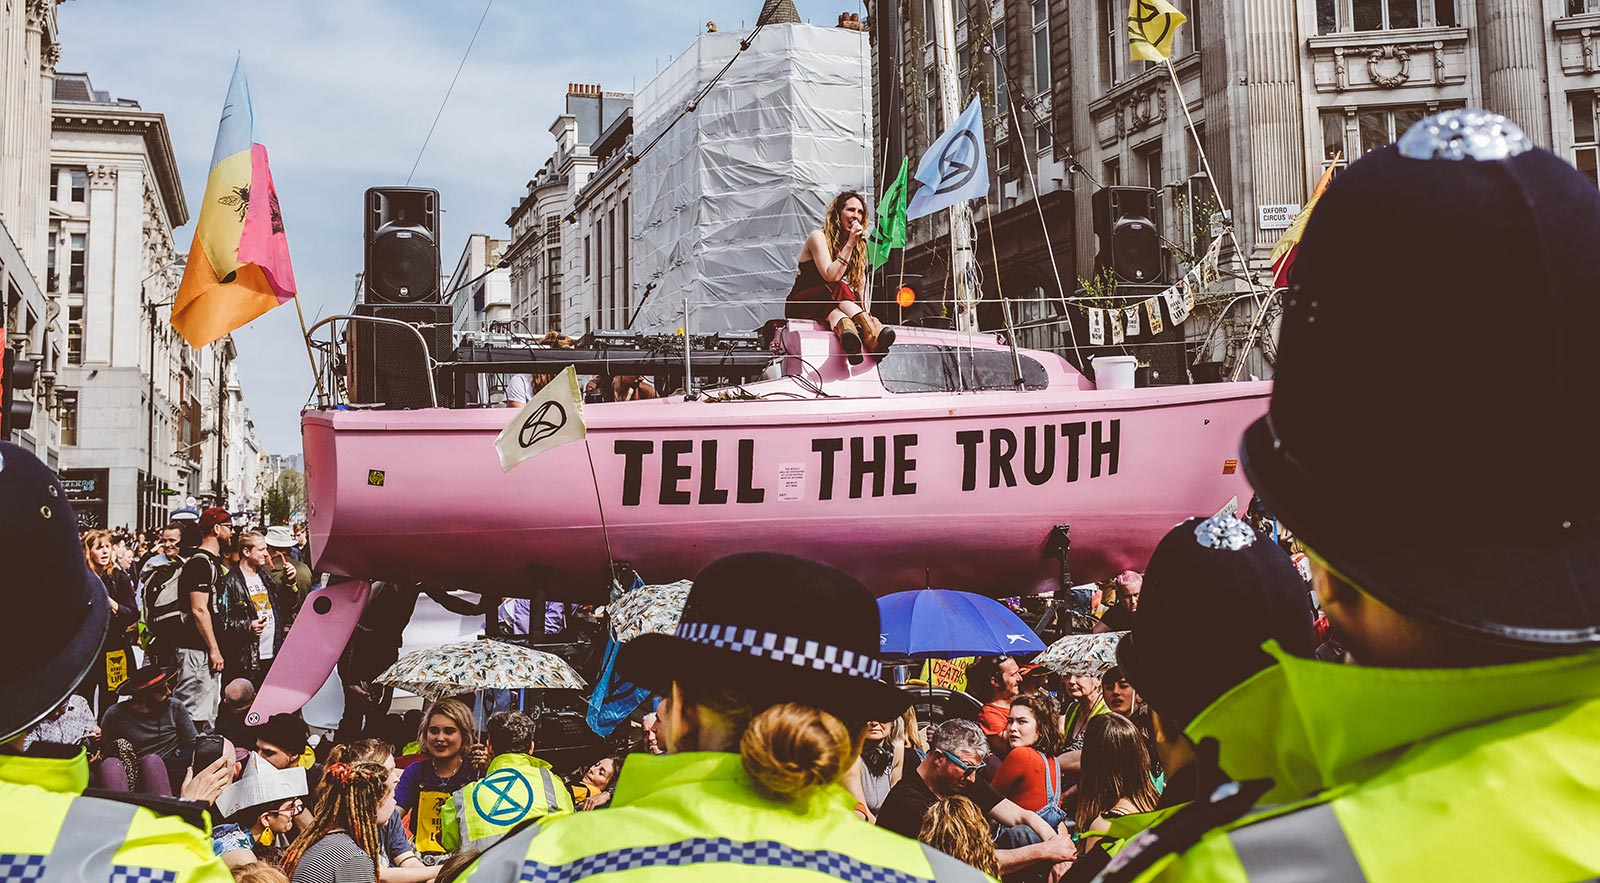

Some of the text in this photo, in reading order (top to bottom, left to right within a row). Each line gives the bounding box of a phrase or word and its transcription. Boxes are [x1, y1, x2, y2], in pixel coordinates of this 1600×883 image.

[1262, 206, 1288, 215] OXFORD
[1262, 214, 1287, 222] CIRCUS
[1173, 307, 1186, 319] LIFE
[614, 418, 1121, 506] TELL THE TRUTH
[933, 661, 964, 685] DEATHS
